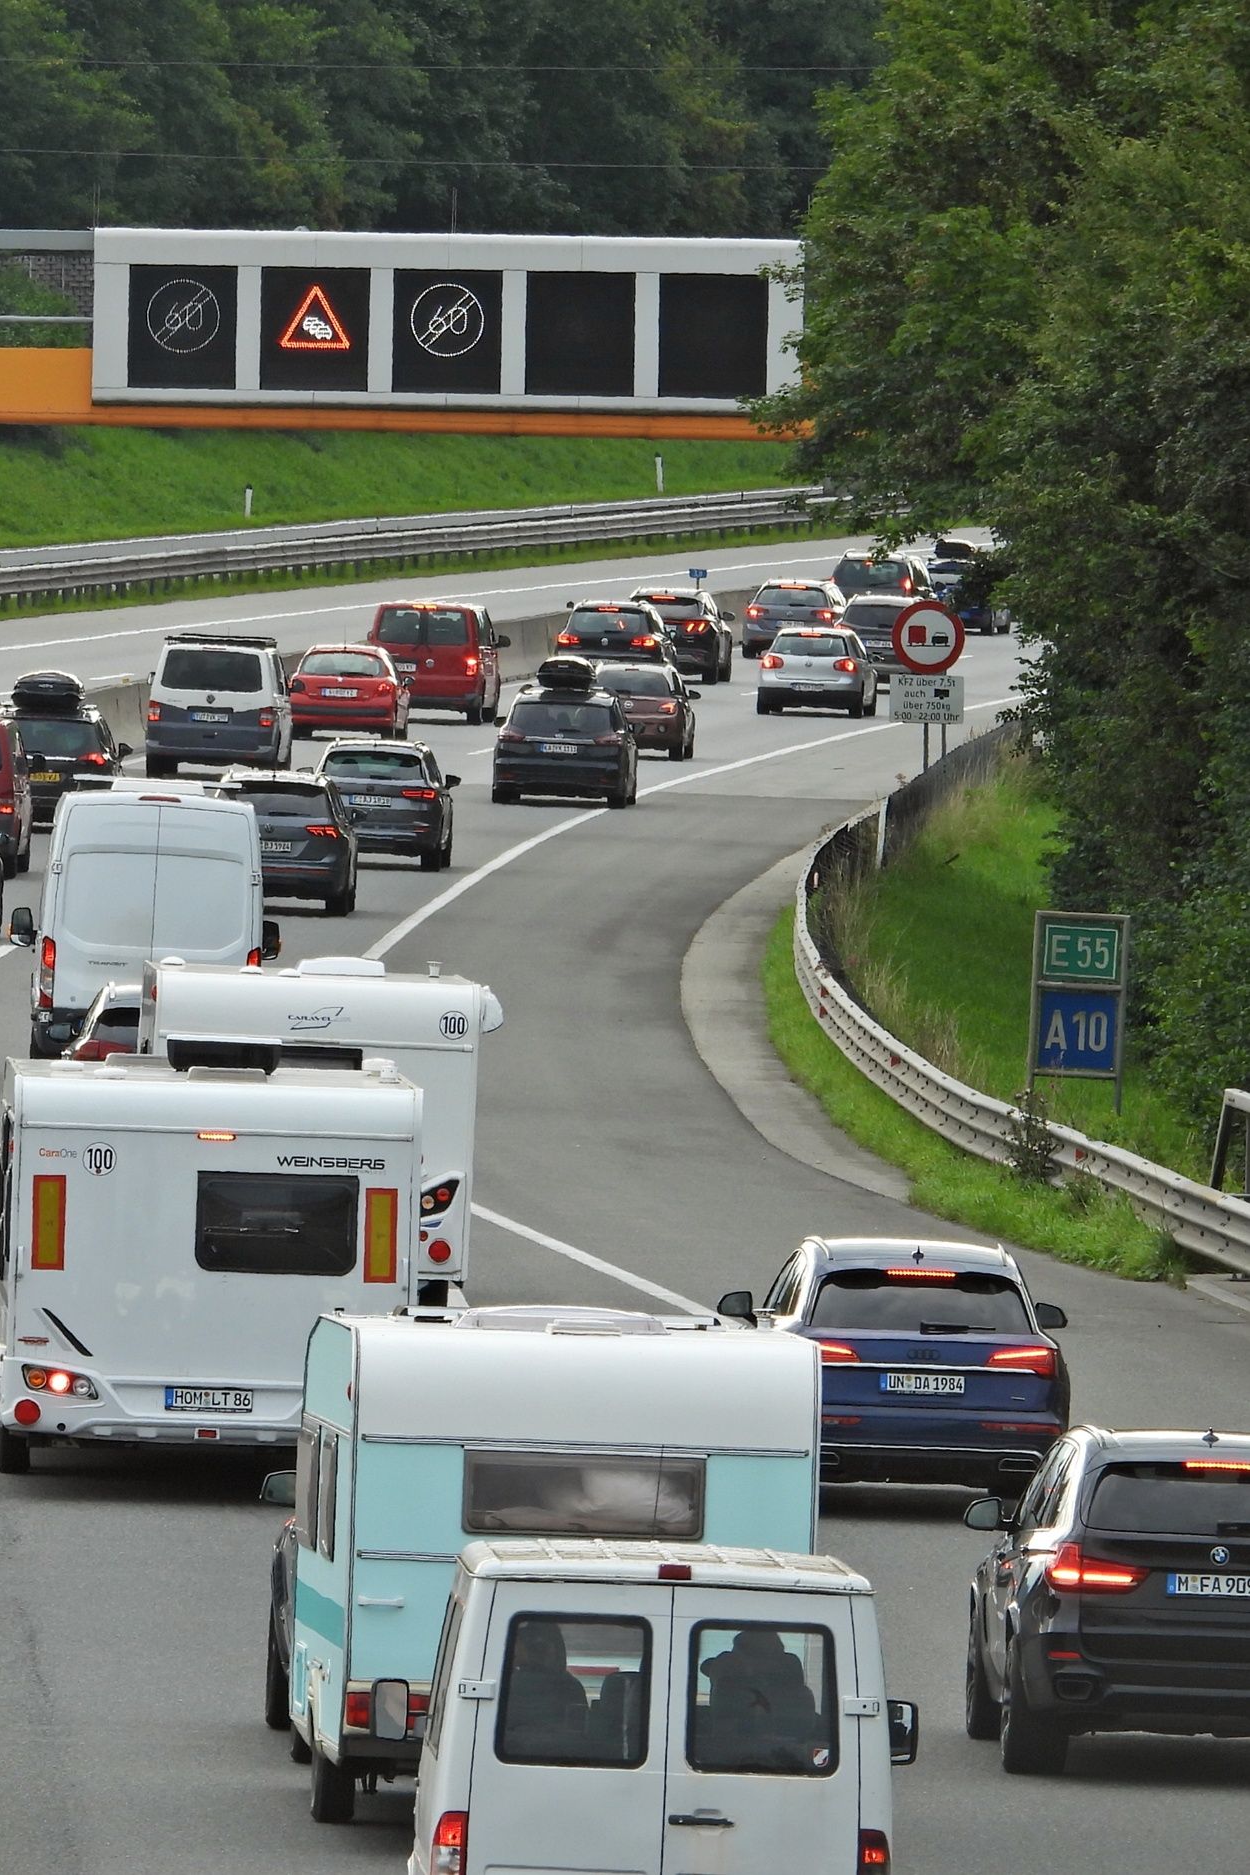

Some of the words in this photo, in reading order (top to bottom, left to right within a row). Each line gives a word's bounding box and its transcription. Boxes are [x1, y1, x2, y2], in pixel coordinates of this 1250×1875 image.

[428, 302, 469, 336] 60
[898, 678, 913, 686] KFZ
[916, 677, 937, 686] über
[904, 690, 926, 698] auch
[903, 701, 923, 710] über
[926, 701, 951, 711] 750kg
[894, 711, 912, 720] 5:00
[918, 712, 941, 721] 22:00
[943, 712, 960, 721] Uhr
[1051, 934, 1071, 967] E
[1077, 936, 1110, 969] 55
[443, 1016, 465, 1035] 100
[1044, 1009, 1067, 1051] A
[1072, 1011, 1108, 1052] 10
[86, 1148, 113, 1169] 100
[277, 1156, 386, 1170] WEINSBERG
[888, 1375, 905, 1389] UN
[914, 1376, 930, 1390] DA
[932, 1377, 963, 1392] 1984
[174, 1390, 203, 1405] HOM
[211, 1392, 231, 1406] LT
[233, 1393, 251, 1407] 86
[1177, 1576, 1189, 1591] M
[1200, 1577, 1222, 1593] FA
